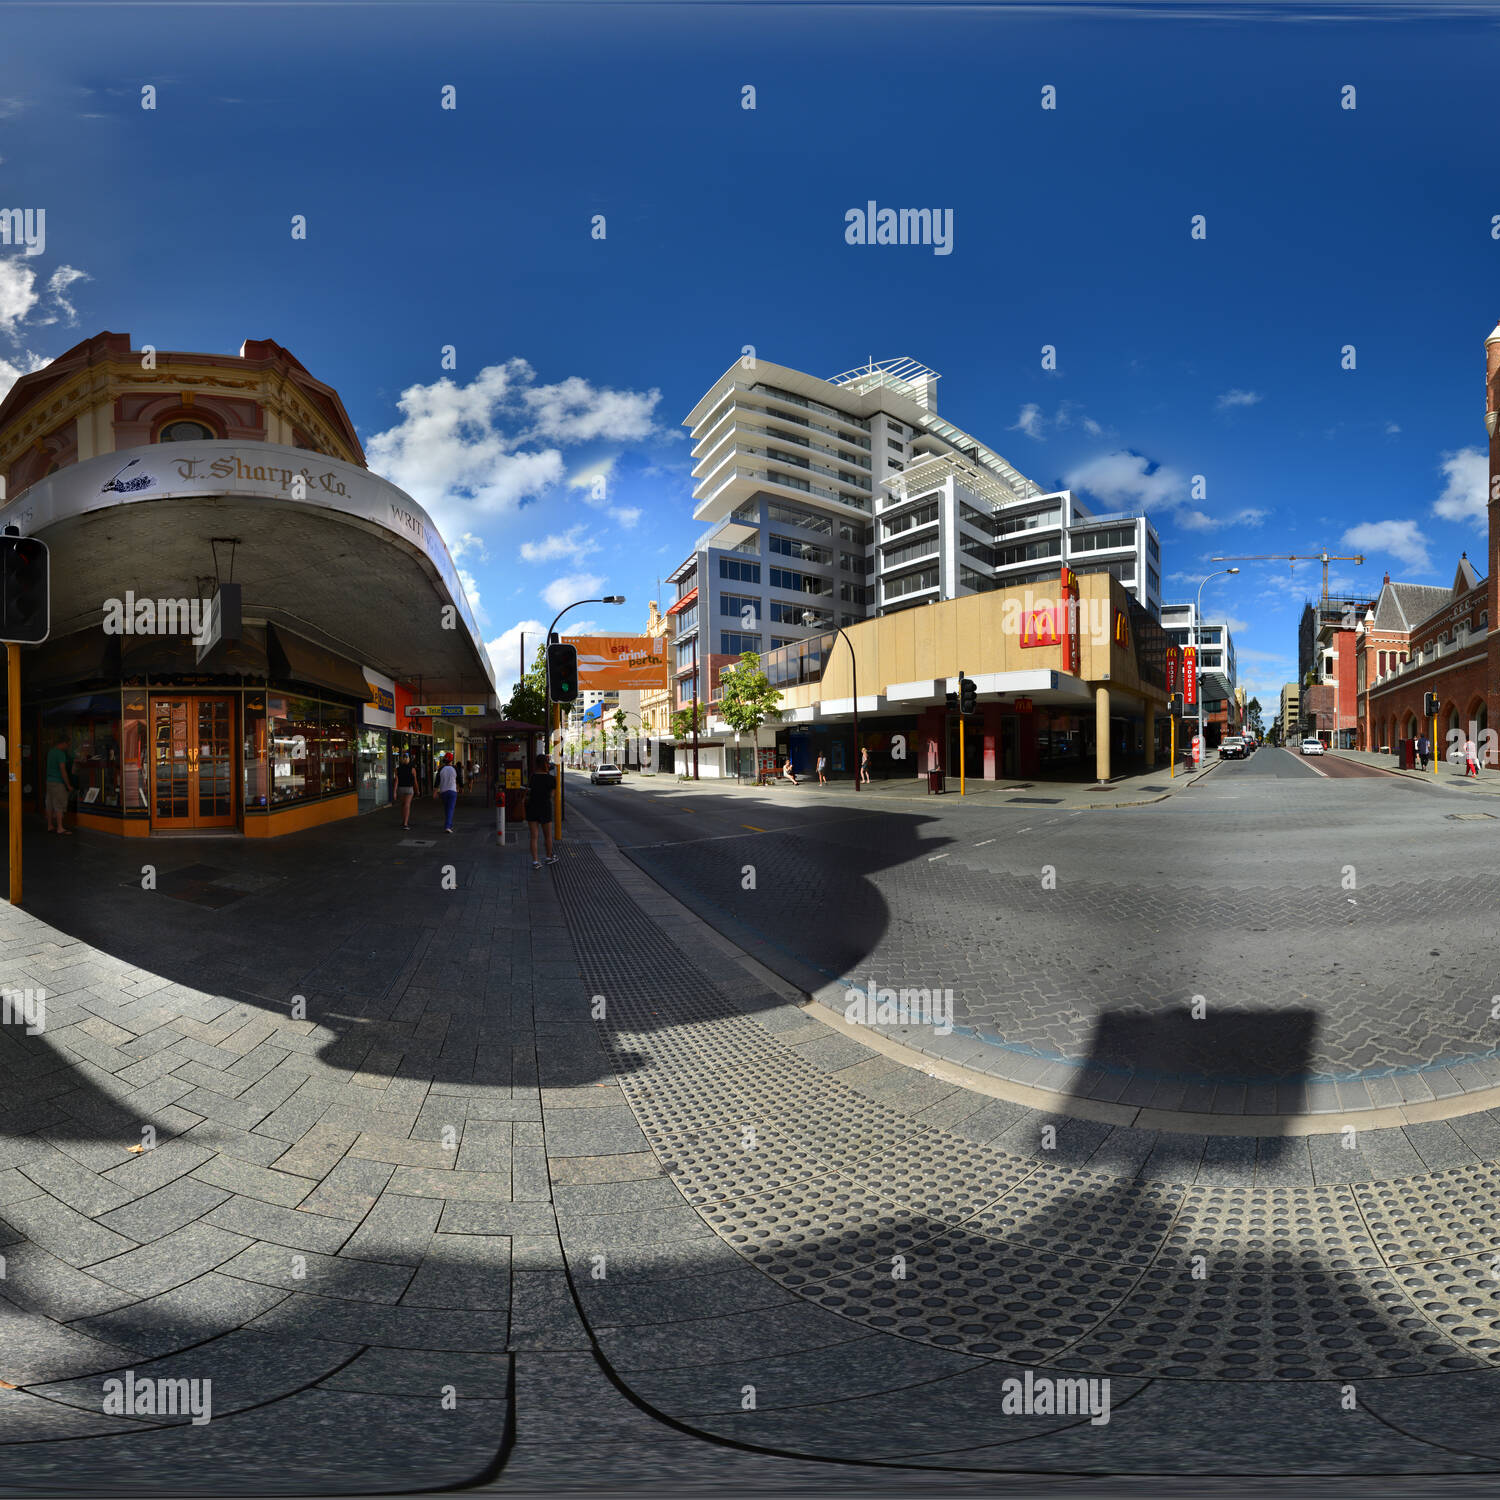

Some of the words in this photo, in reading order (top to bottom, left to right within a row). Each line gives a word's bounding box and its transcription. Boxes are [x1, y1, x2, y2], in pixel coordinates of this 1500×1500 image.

[209, 455, 293, 490] Sharp
[301, 467, 317, 488] &
[320, 471, 352, 499] Co.
[610, 645, 629, 654] eat
[618, 649, 648, 661] drink
